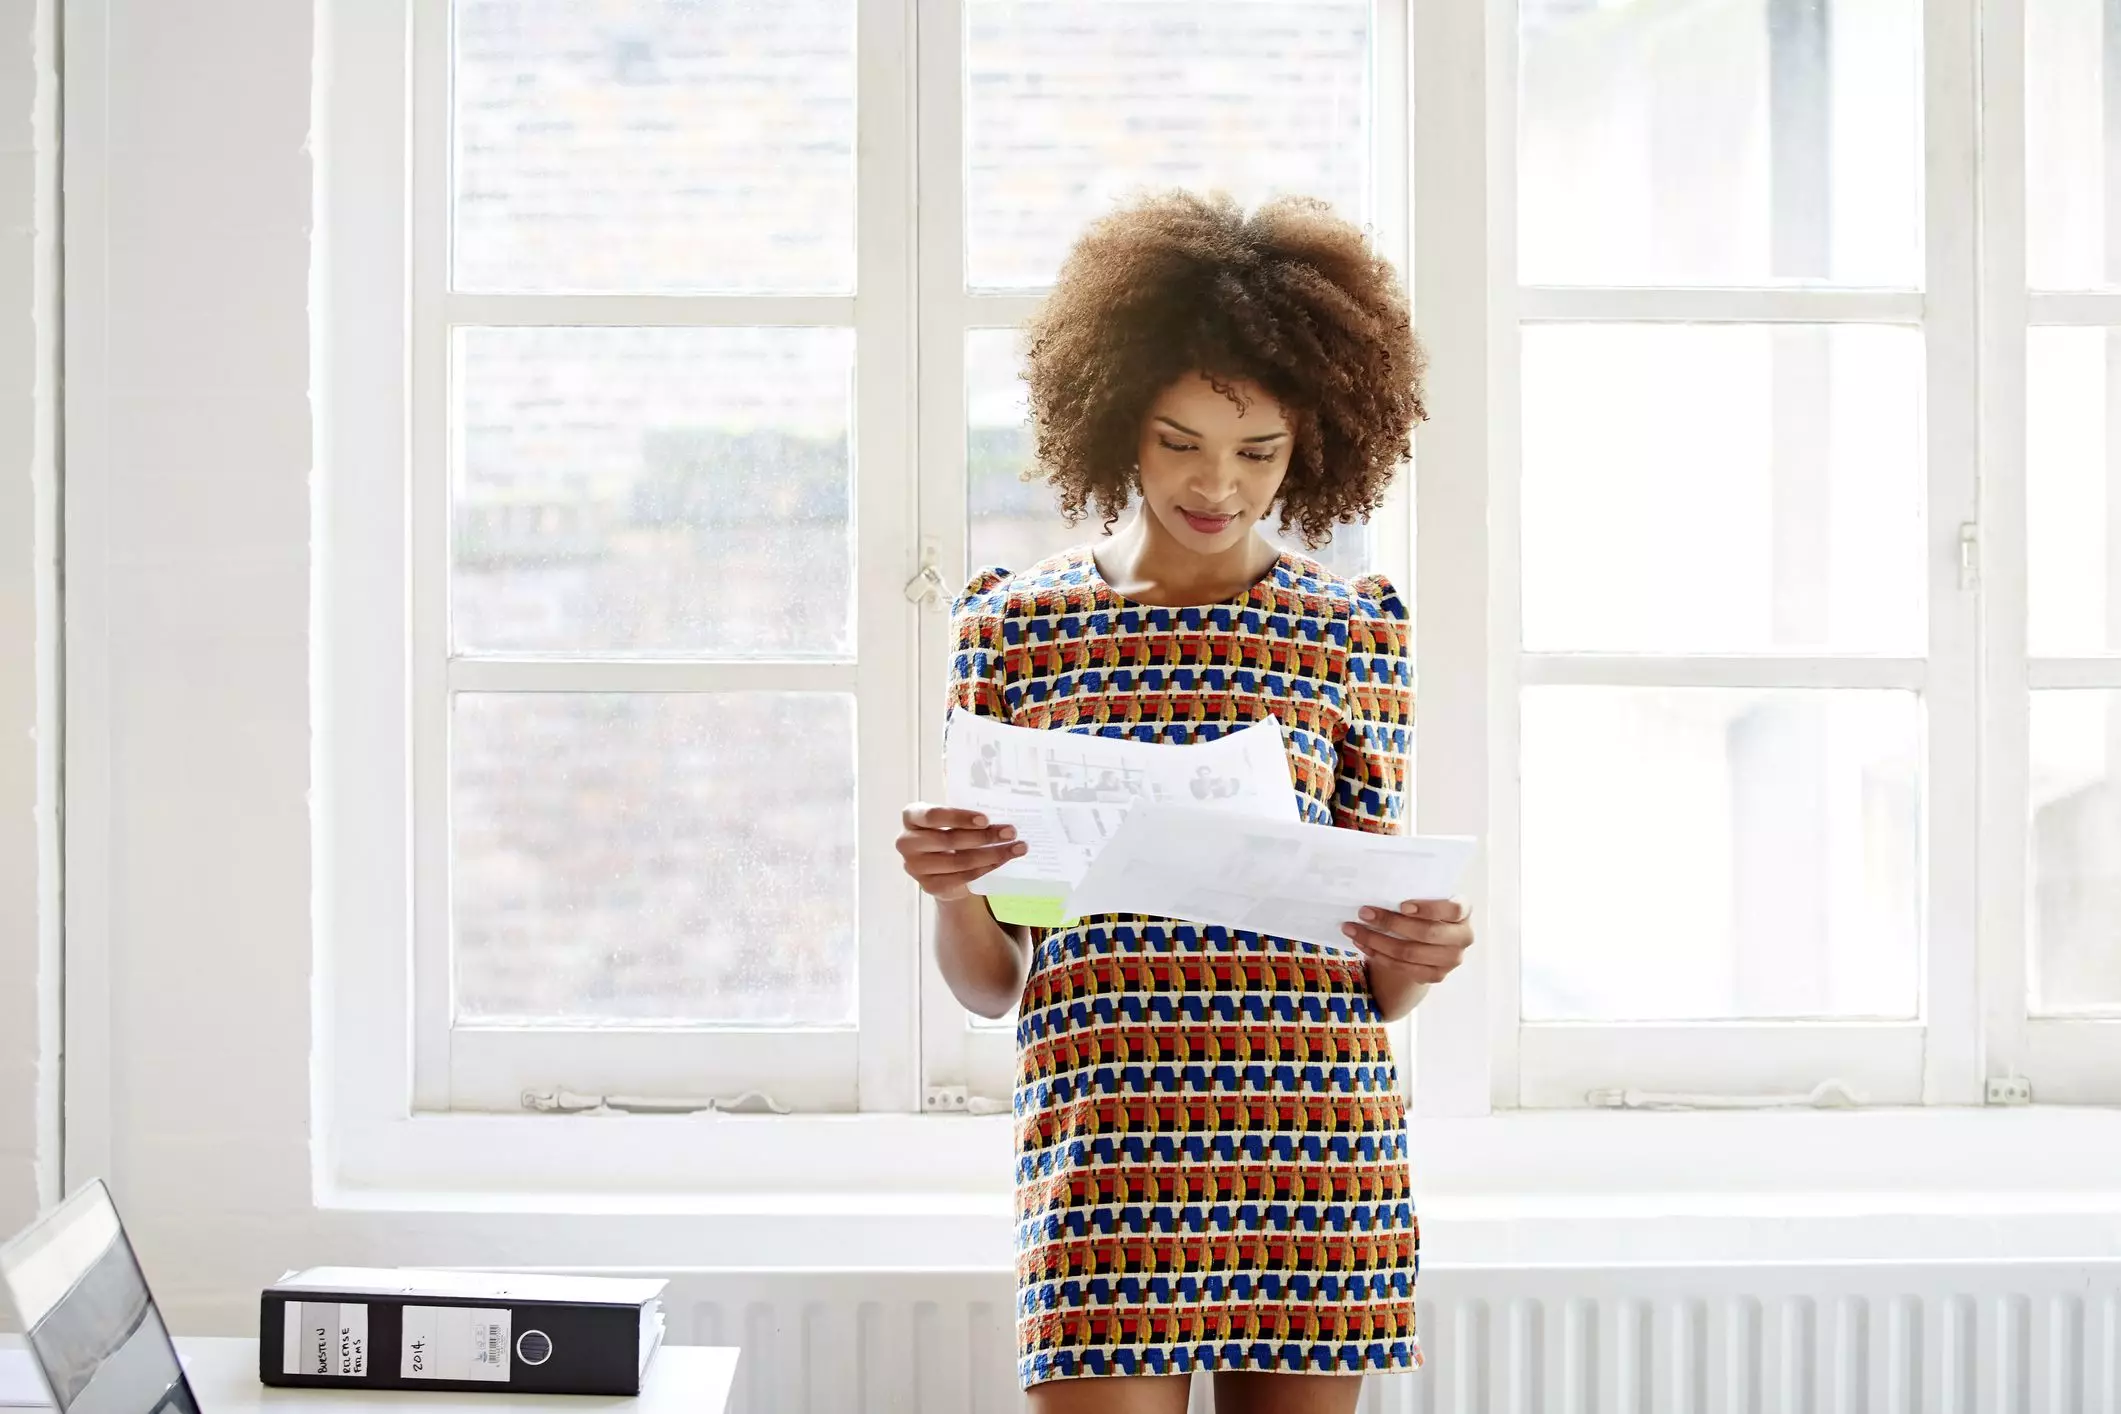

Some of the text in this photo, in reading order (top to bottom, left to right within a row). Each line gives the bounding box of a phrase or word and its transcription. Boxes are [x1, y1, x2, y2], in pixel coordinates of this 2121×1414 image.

[316, 1328, 328, 1374] BURSTEIN
[342, 1328, 351, 1374] RELEASE
[353, 1339, 362, 1374] FORMS
